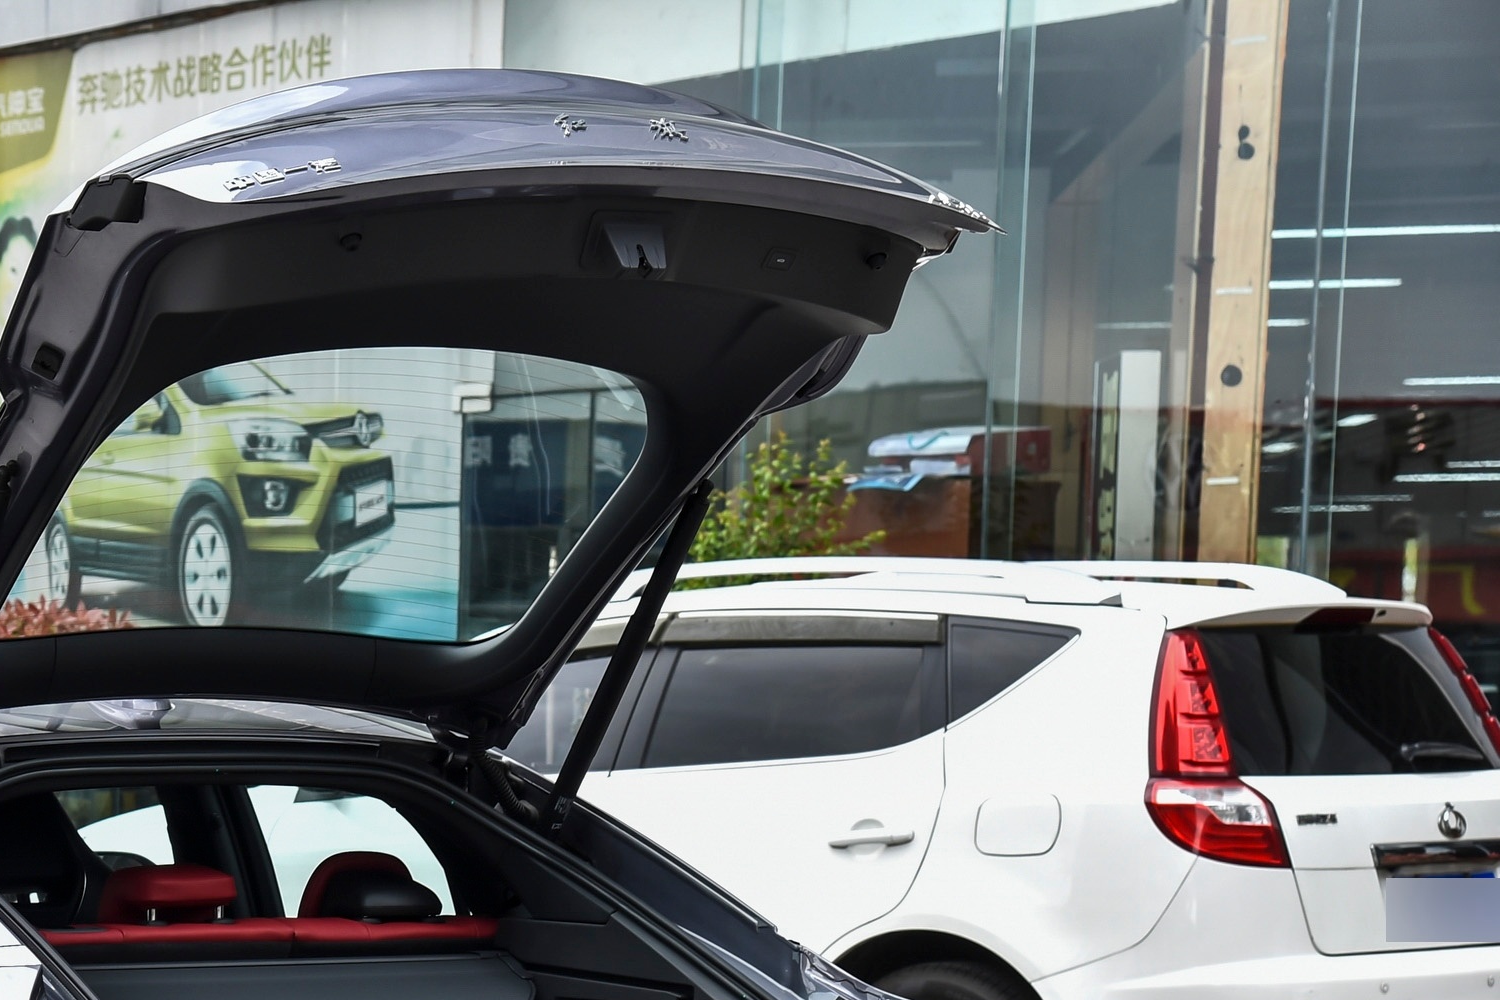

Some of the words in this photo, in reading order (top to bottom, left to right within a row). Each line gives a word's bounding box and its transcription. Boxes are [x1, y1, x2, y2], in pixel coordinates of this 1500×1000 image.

[78, 34, 332, 115] 奔驰技术战略合作伙伴
